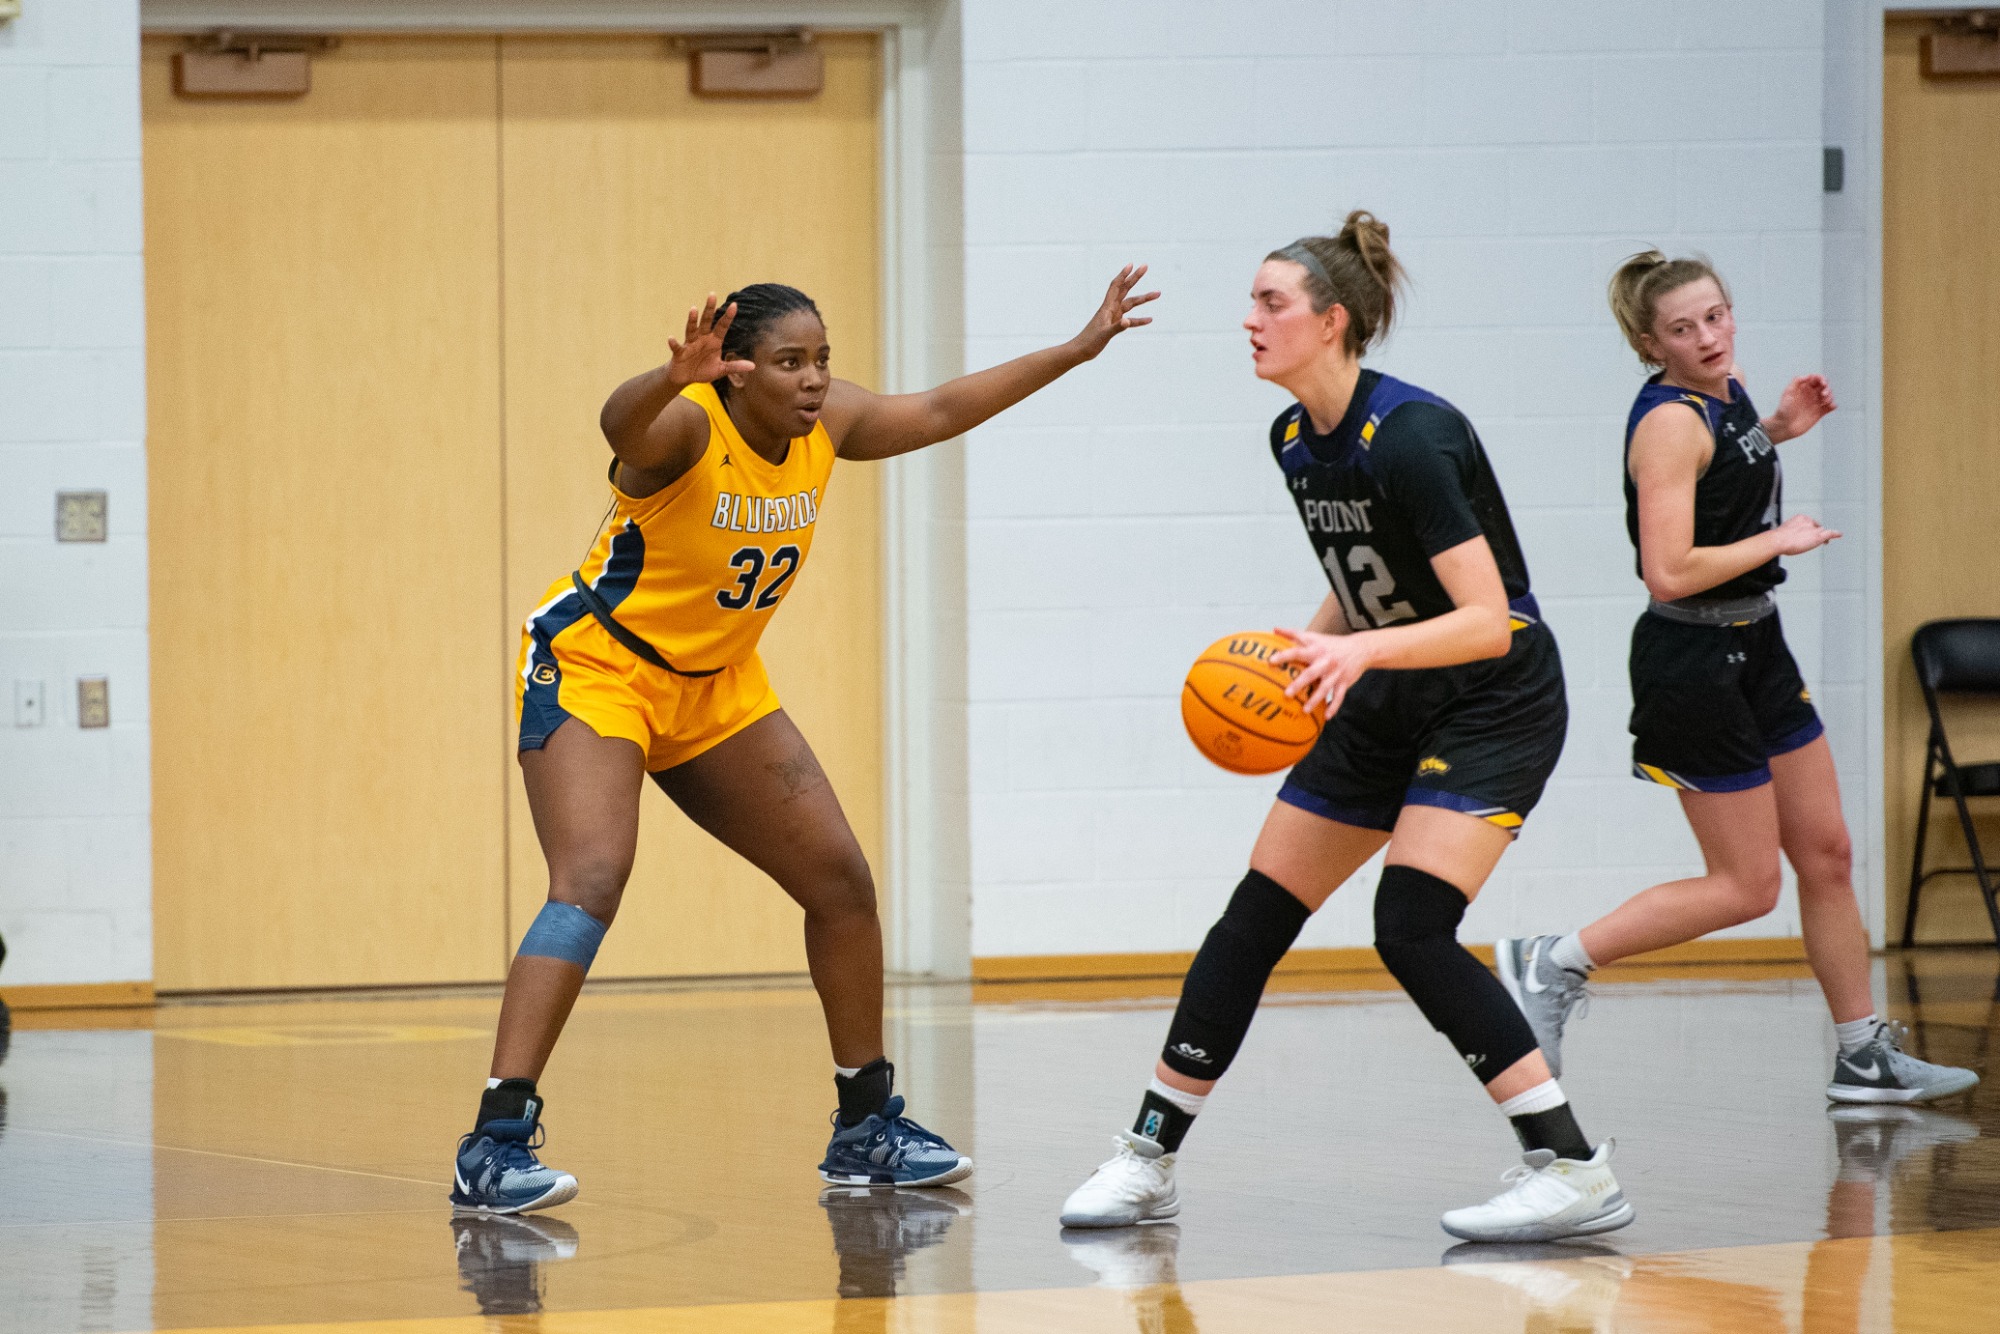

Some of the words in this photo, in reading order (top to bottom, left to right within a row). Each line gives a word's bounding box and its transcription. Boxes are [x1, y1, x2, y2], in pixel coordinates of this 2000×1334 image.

[711, 486, 818, 533] BLUGOLDS
[1303, 498, 1374, 533] POINT
[714, 544, 801, 612] 32
[1322, 545, 1419, 631] 12
